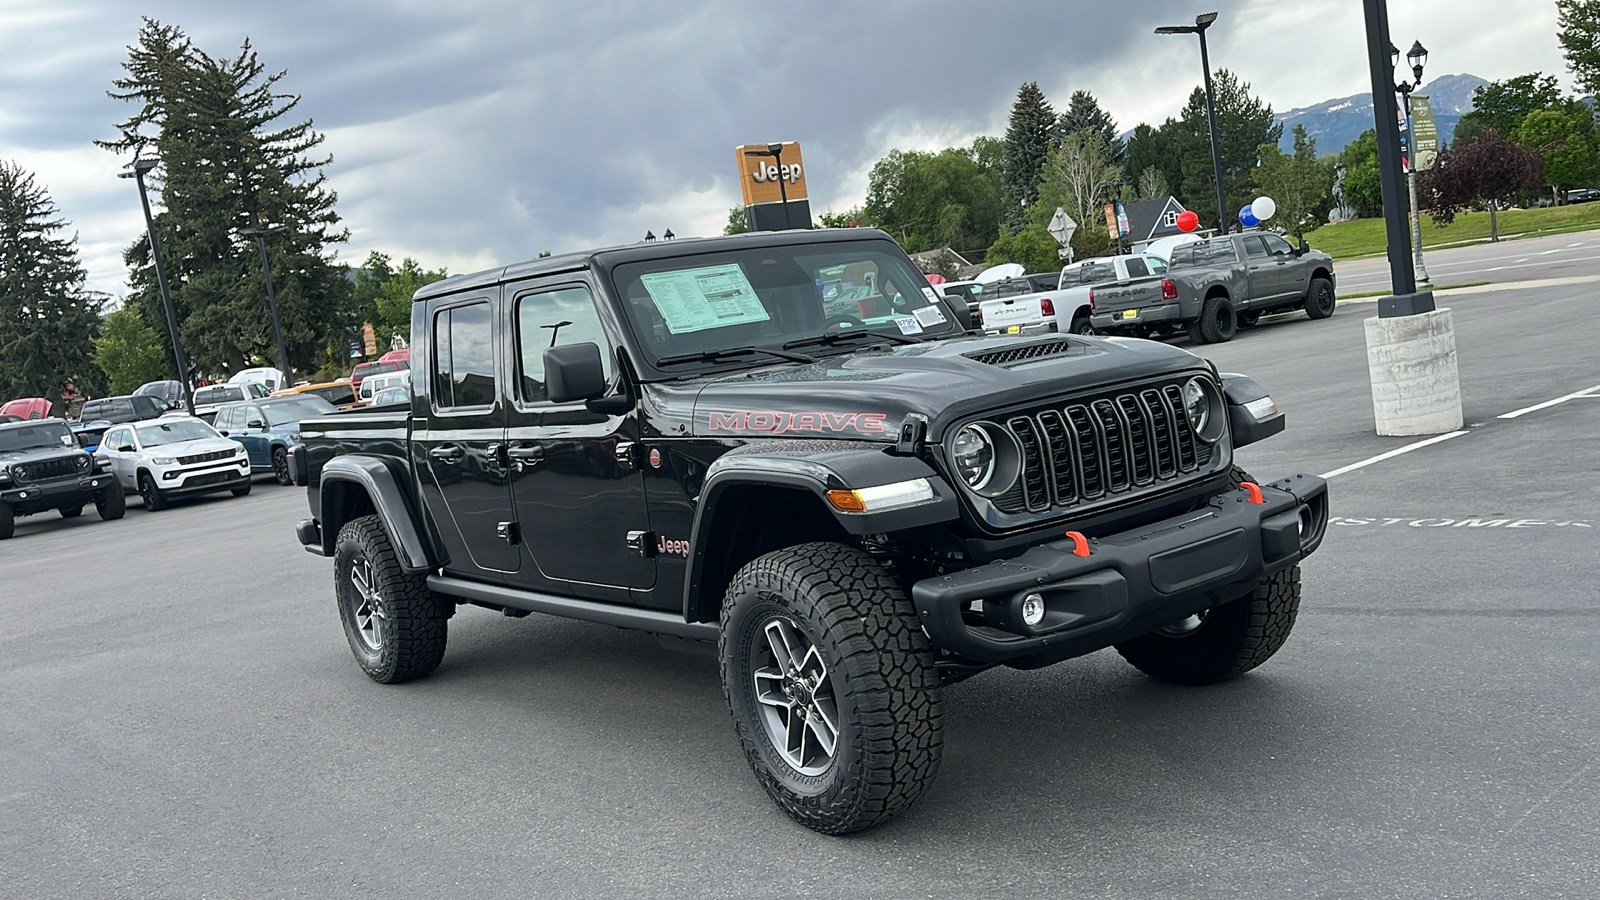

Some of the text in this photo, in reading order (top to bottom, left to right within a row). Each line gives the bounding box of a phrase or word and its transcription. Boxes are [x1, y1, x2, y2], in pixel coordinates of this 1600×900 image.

[753, 161, 802, 184] Jeep
[1108, 287, 1146, 299] RAM
[709, 411, 886, 433] MOJAVE
[657, 535, 690, 558] Jeep
